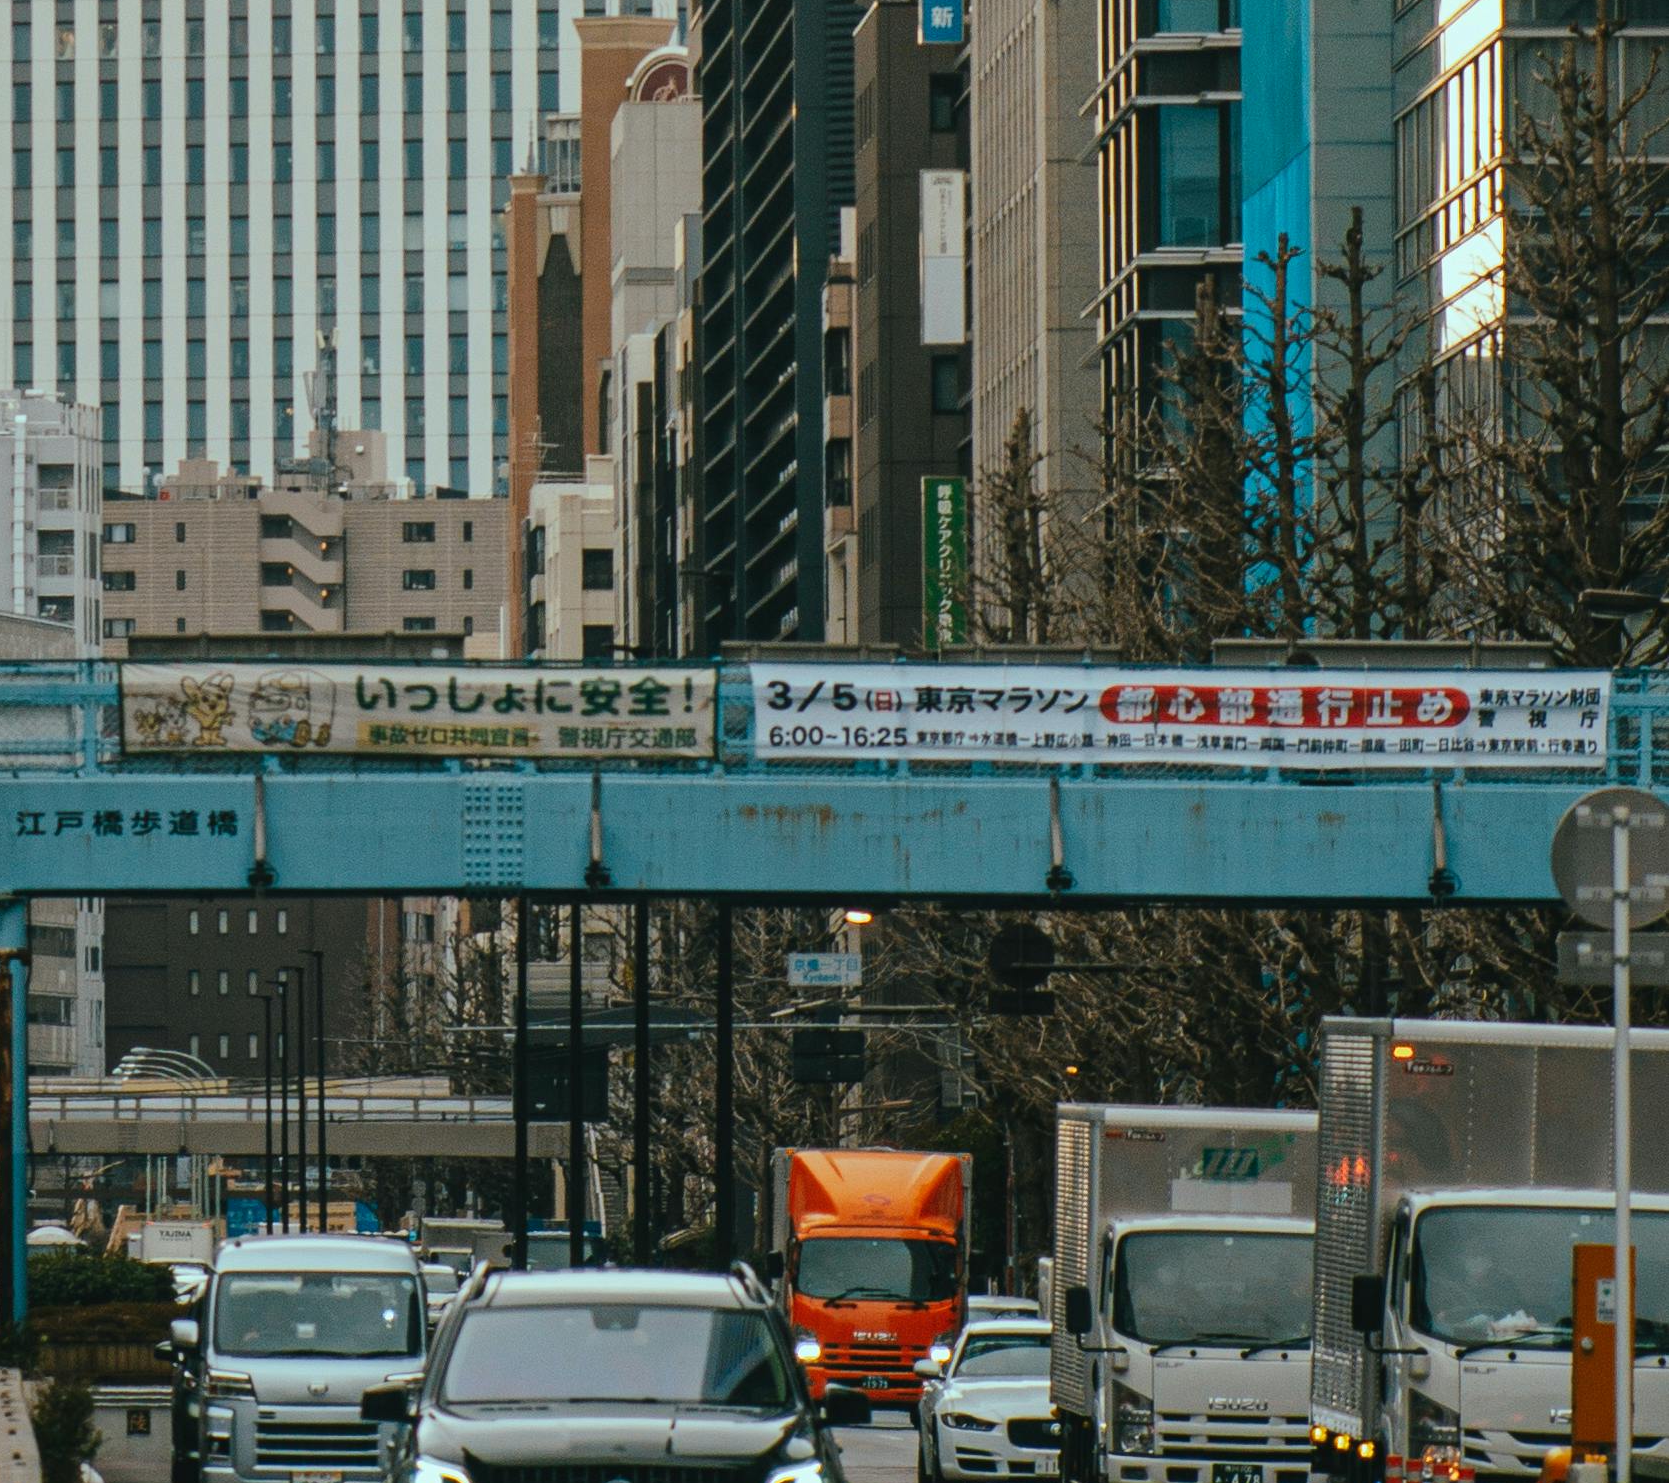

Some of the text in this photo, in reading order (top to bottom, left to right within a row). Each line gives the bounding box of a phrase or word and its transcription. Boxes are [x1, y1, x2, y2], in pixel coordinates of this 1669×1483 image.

[915, 685, 1089, 714] 東京マラソン
[1116, 686, 1454, 727] 都心部通行止め
[1479, 688, 1601, 708] 東京マラソン財団
[1478, 709, 1599, 728] 警視庁
[558, 726, 697, 750] 警視庁交通部
[16, 810, 240, 838] 江戸橋歩道橋
[1208, 1397, 1269, 1412] ISUZU
